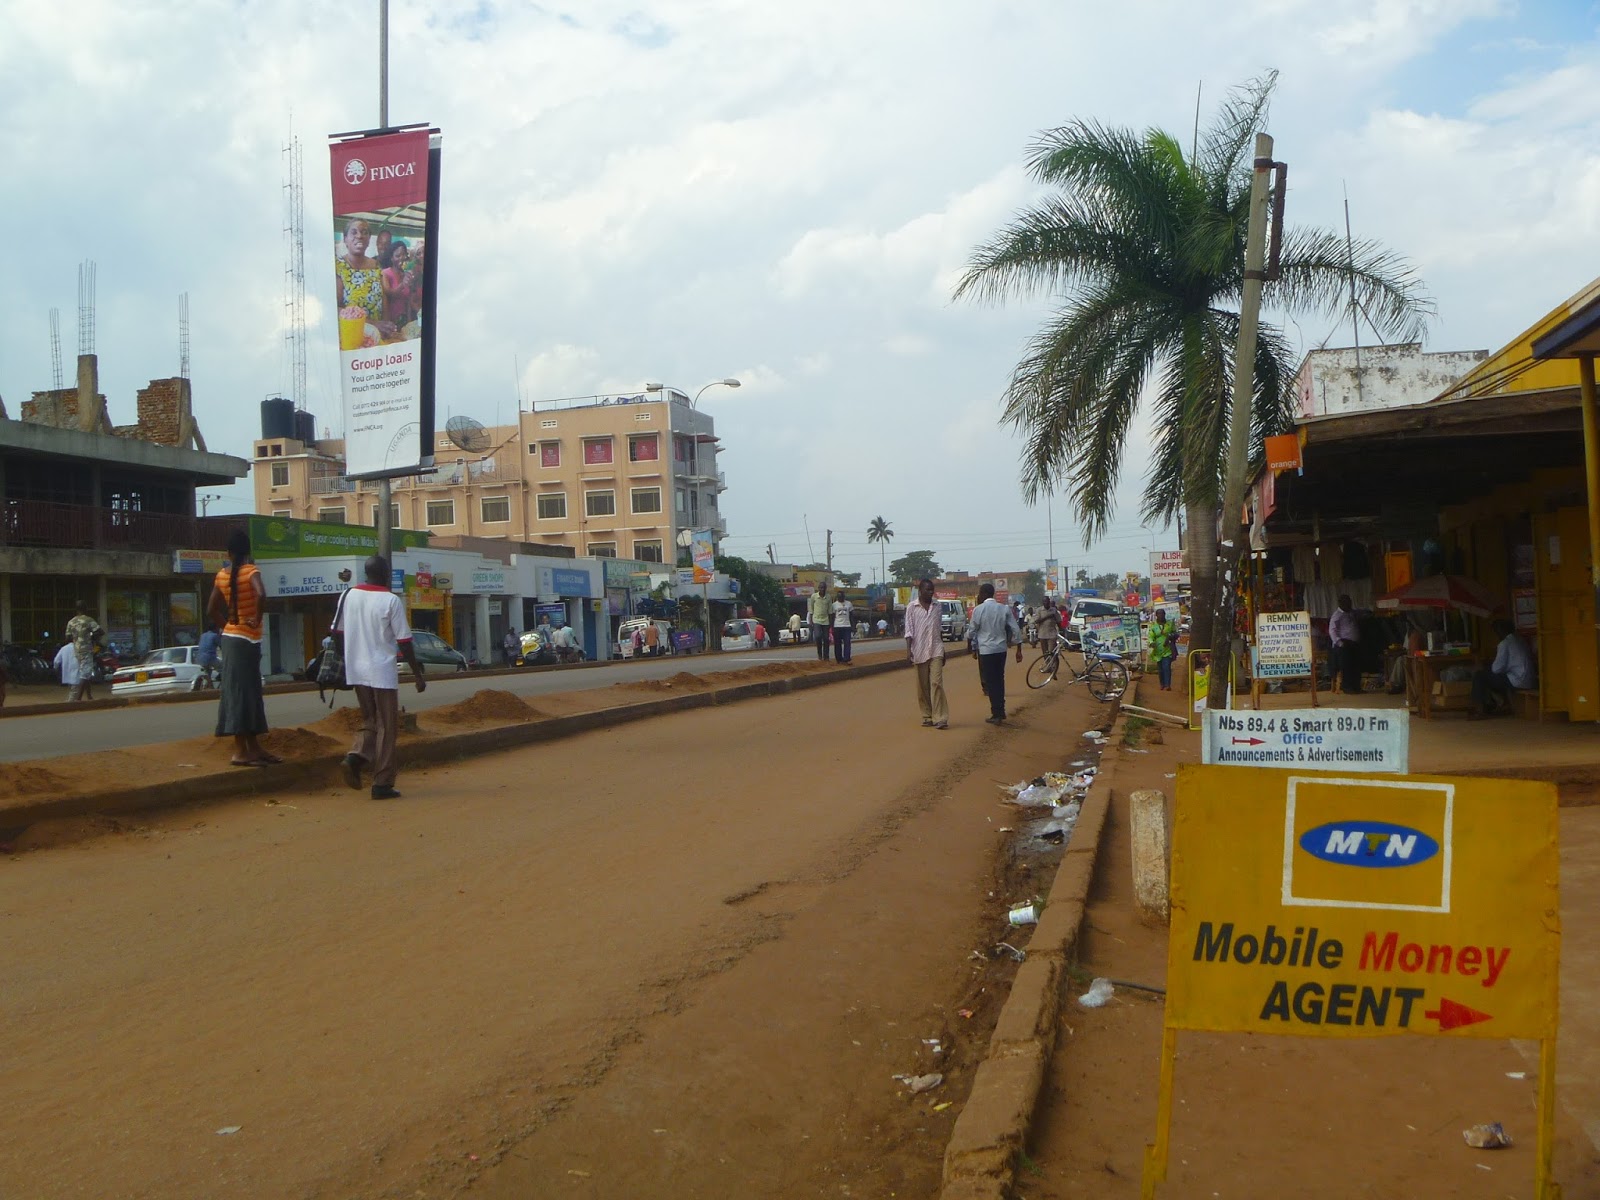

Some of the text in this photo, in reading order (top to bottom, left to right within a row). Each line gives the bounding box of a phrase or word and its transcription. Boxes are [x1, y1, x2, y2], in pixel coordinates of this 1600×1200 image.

[370, 163, 415, 181] FINCA
[351, 352, 413, 371] Group Loans
[351, 375, 365, 383] You
[366, 374, 375, 382] can
[376, 370, 398, 380] achieve
[352, 377, 410, 393] much more together
[1270, 460, 1297, 469] orange
[1162, 552, 1183, 560] ALISH
[303, 577, 325, 585] EXCEL
[278, 583, 349, 595] INSURANCE CO LTD
[1267, 613, 1299, 623] REMMY
[1260, 624, 1309, 632] STATIONERY
[1218, 715, 1389, 733] Nbs 89.4 & Smart 89.0 Fm
[1283, 733, 1323, 744] Office
[1218, 747, 1384, 762] Announcements & Advertisements
[1325, 830, 1417, 859] MTN
[1193, 921, 1511, 987] Mobile Money
[1259, 981, 1425, 1028] AGENT
